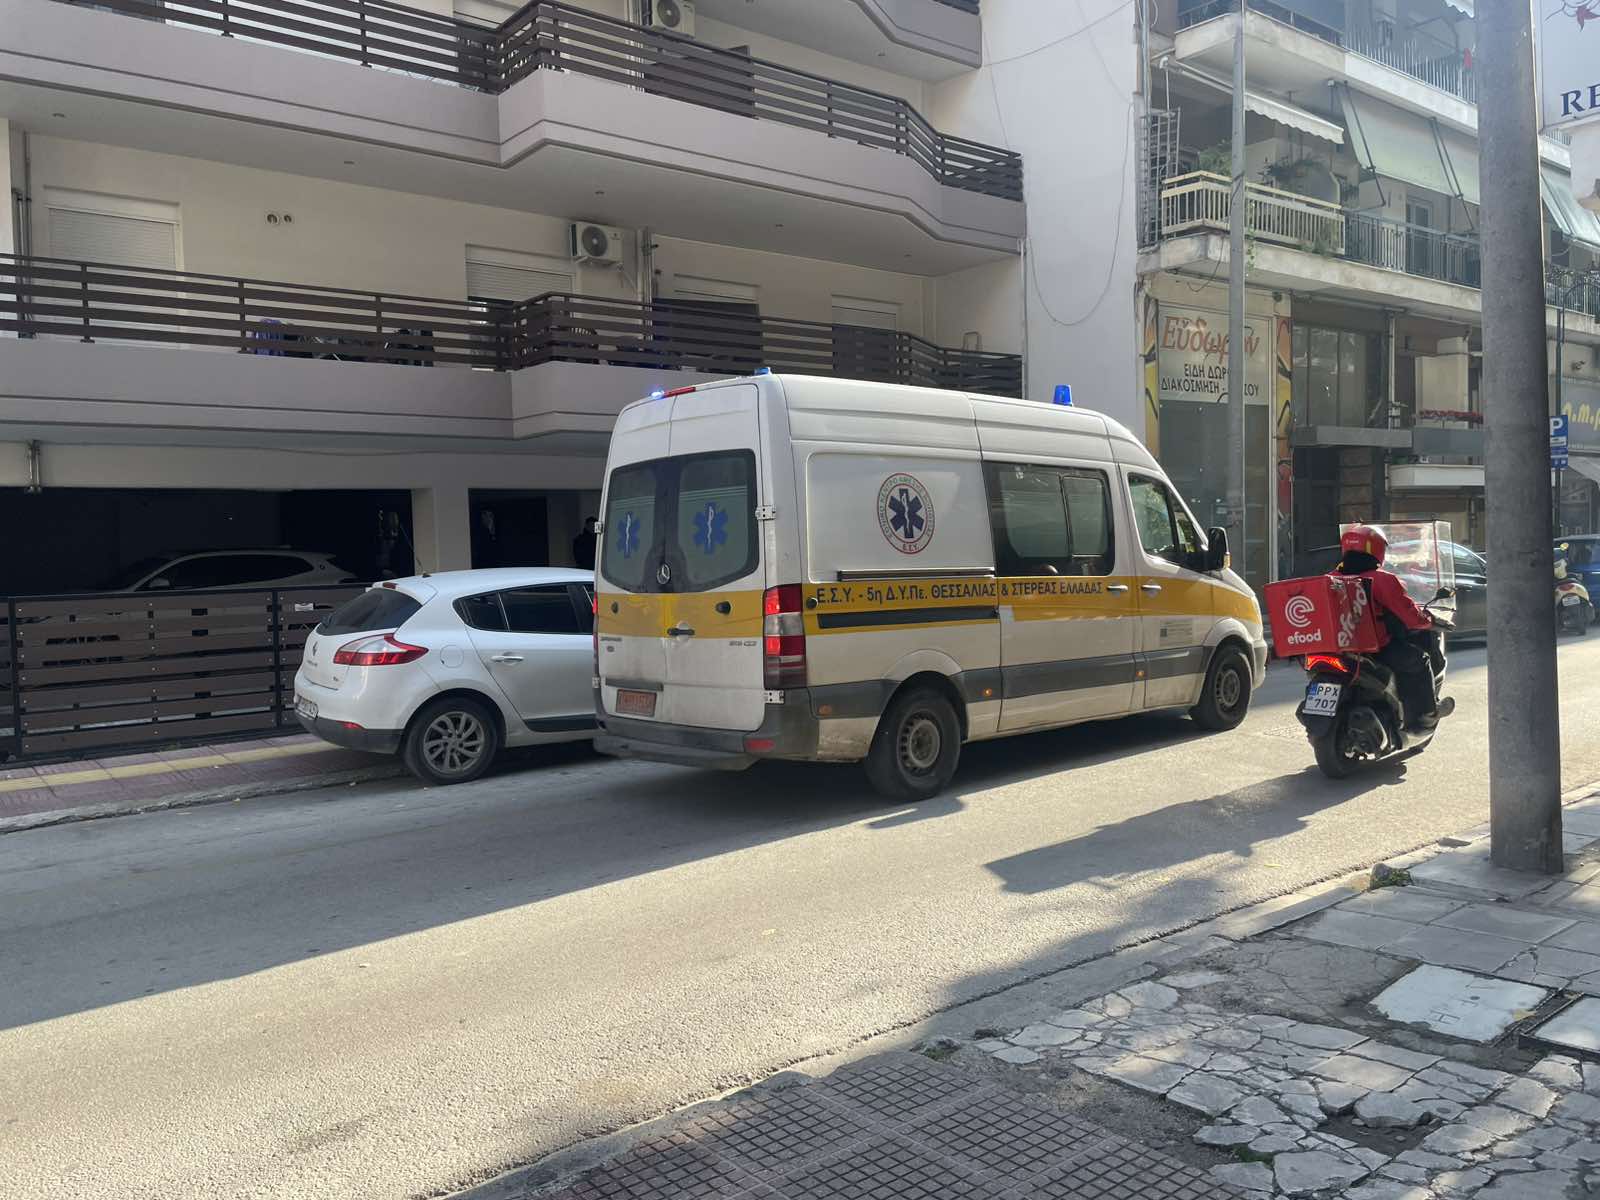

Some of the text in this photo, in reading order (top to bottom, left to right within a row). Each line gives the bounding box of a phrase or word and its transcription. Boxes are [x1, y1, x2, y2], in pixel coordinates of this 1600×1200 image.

[1184, 363, 1206, 377] ΕΙΔΗ
[1161, 378, 1220, 394] ΔΙΑΚΟΣΜΗΣΗ
[816, 587, 855, 604] Ε.Σ.Υ.
[866, 586, 883, 604] 5η
[885, 584, 928, 600] Δ.Υ.Πε.
[931, 582, 996, 598] ΘΕΣΣΑΛΙΑΣ
[1001, 583, 1009, 596] &
[1012, 582, 1058, 596] ΣΤΕΡΕΑΣ
[1060, 581, 1103, 595] ΕΛΛΑΔΑΣ
[1287, 628, 1322, 645] efood
[1316, 685, 1338, 697] PPX
[1314, 698, 1337, 710] 707
